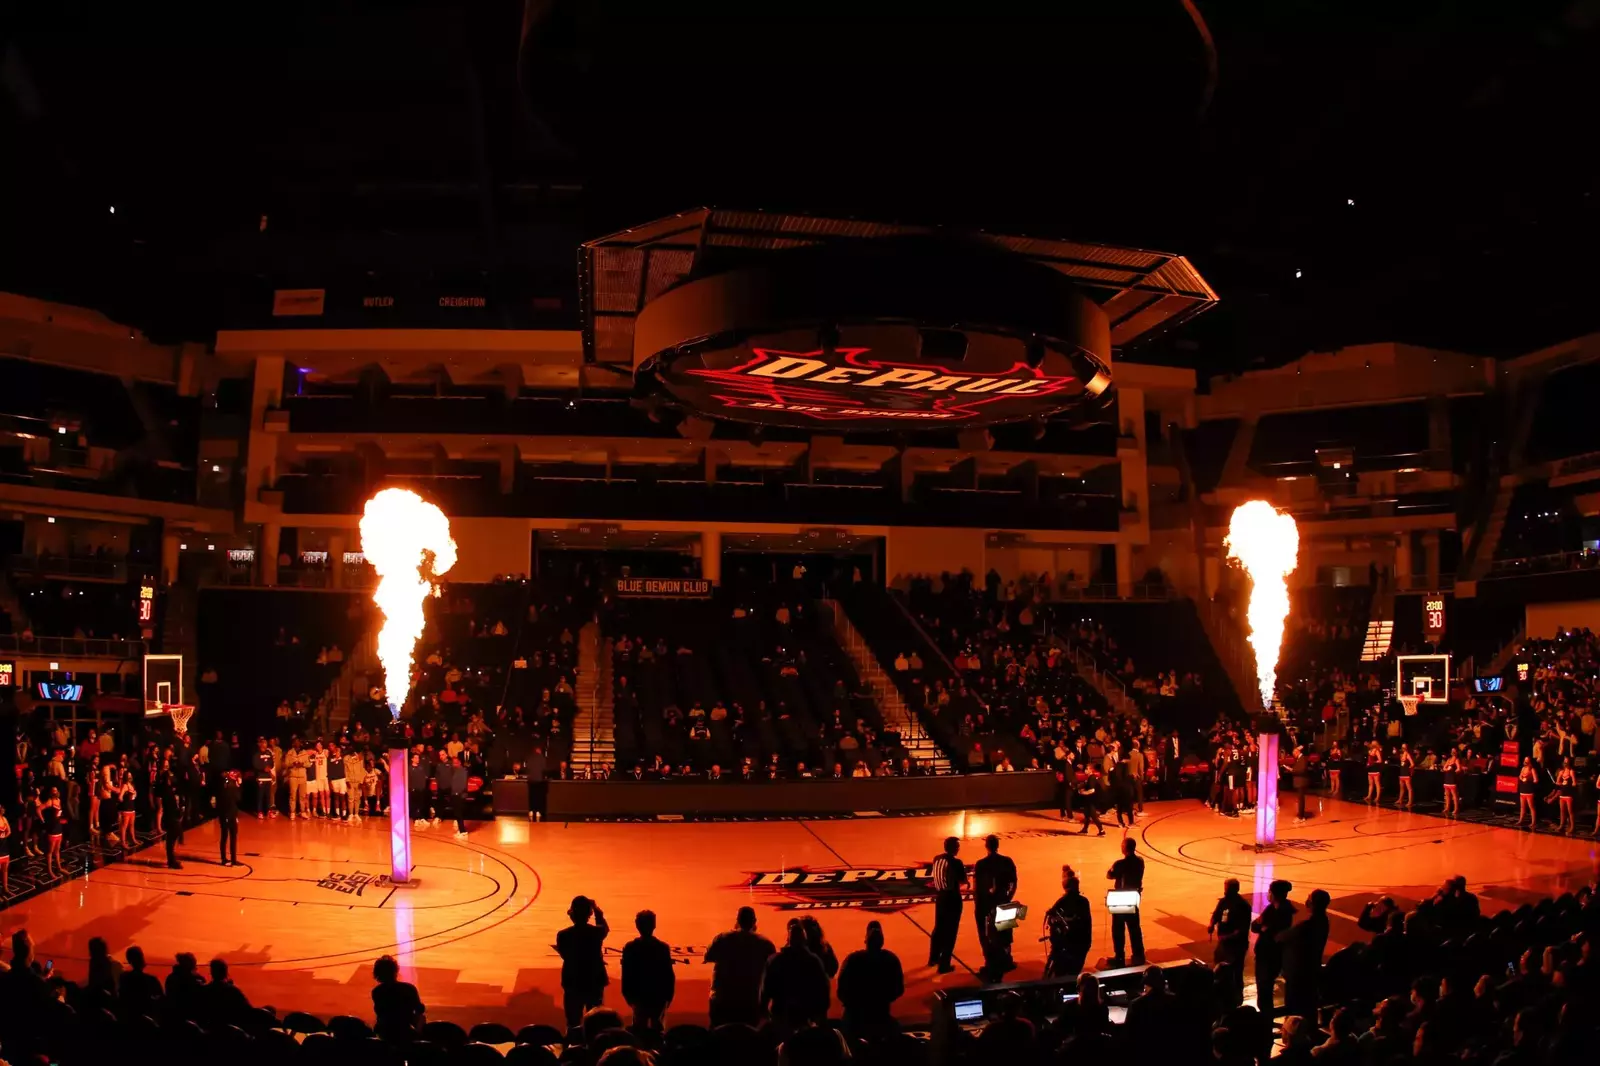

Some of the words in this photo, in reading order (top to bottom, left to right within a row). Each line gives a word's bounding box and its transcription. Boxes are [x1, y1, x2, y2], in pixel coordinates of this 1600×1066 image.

[362, 296, 394, 307] BUTLER
[438, 296, 486, 307] CREIGHTON
[617, 580, 643, 593] BLUE
[645, 580, 681, 593] DEMON
[683, 581, 709, 593] CLUB
[140, 600, 151, 620] 30
[1426, 600, 1443, 611] 20:00
[1429, 611, 1442, 628] 30
[756, 867, 975, 885] DEPAU
[795, 900, 864, 909] BLUE
